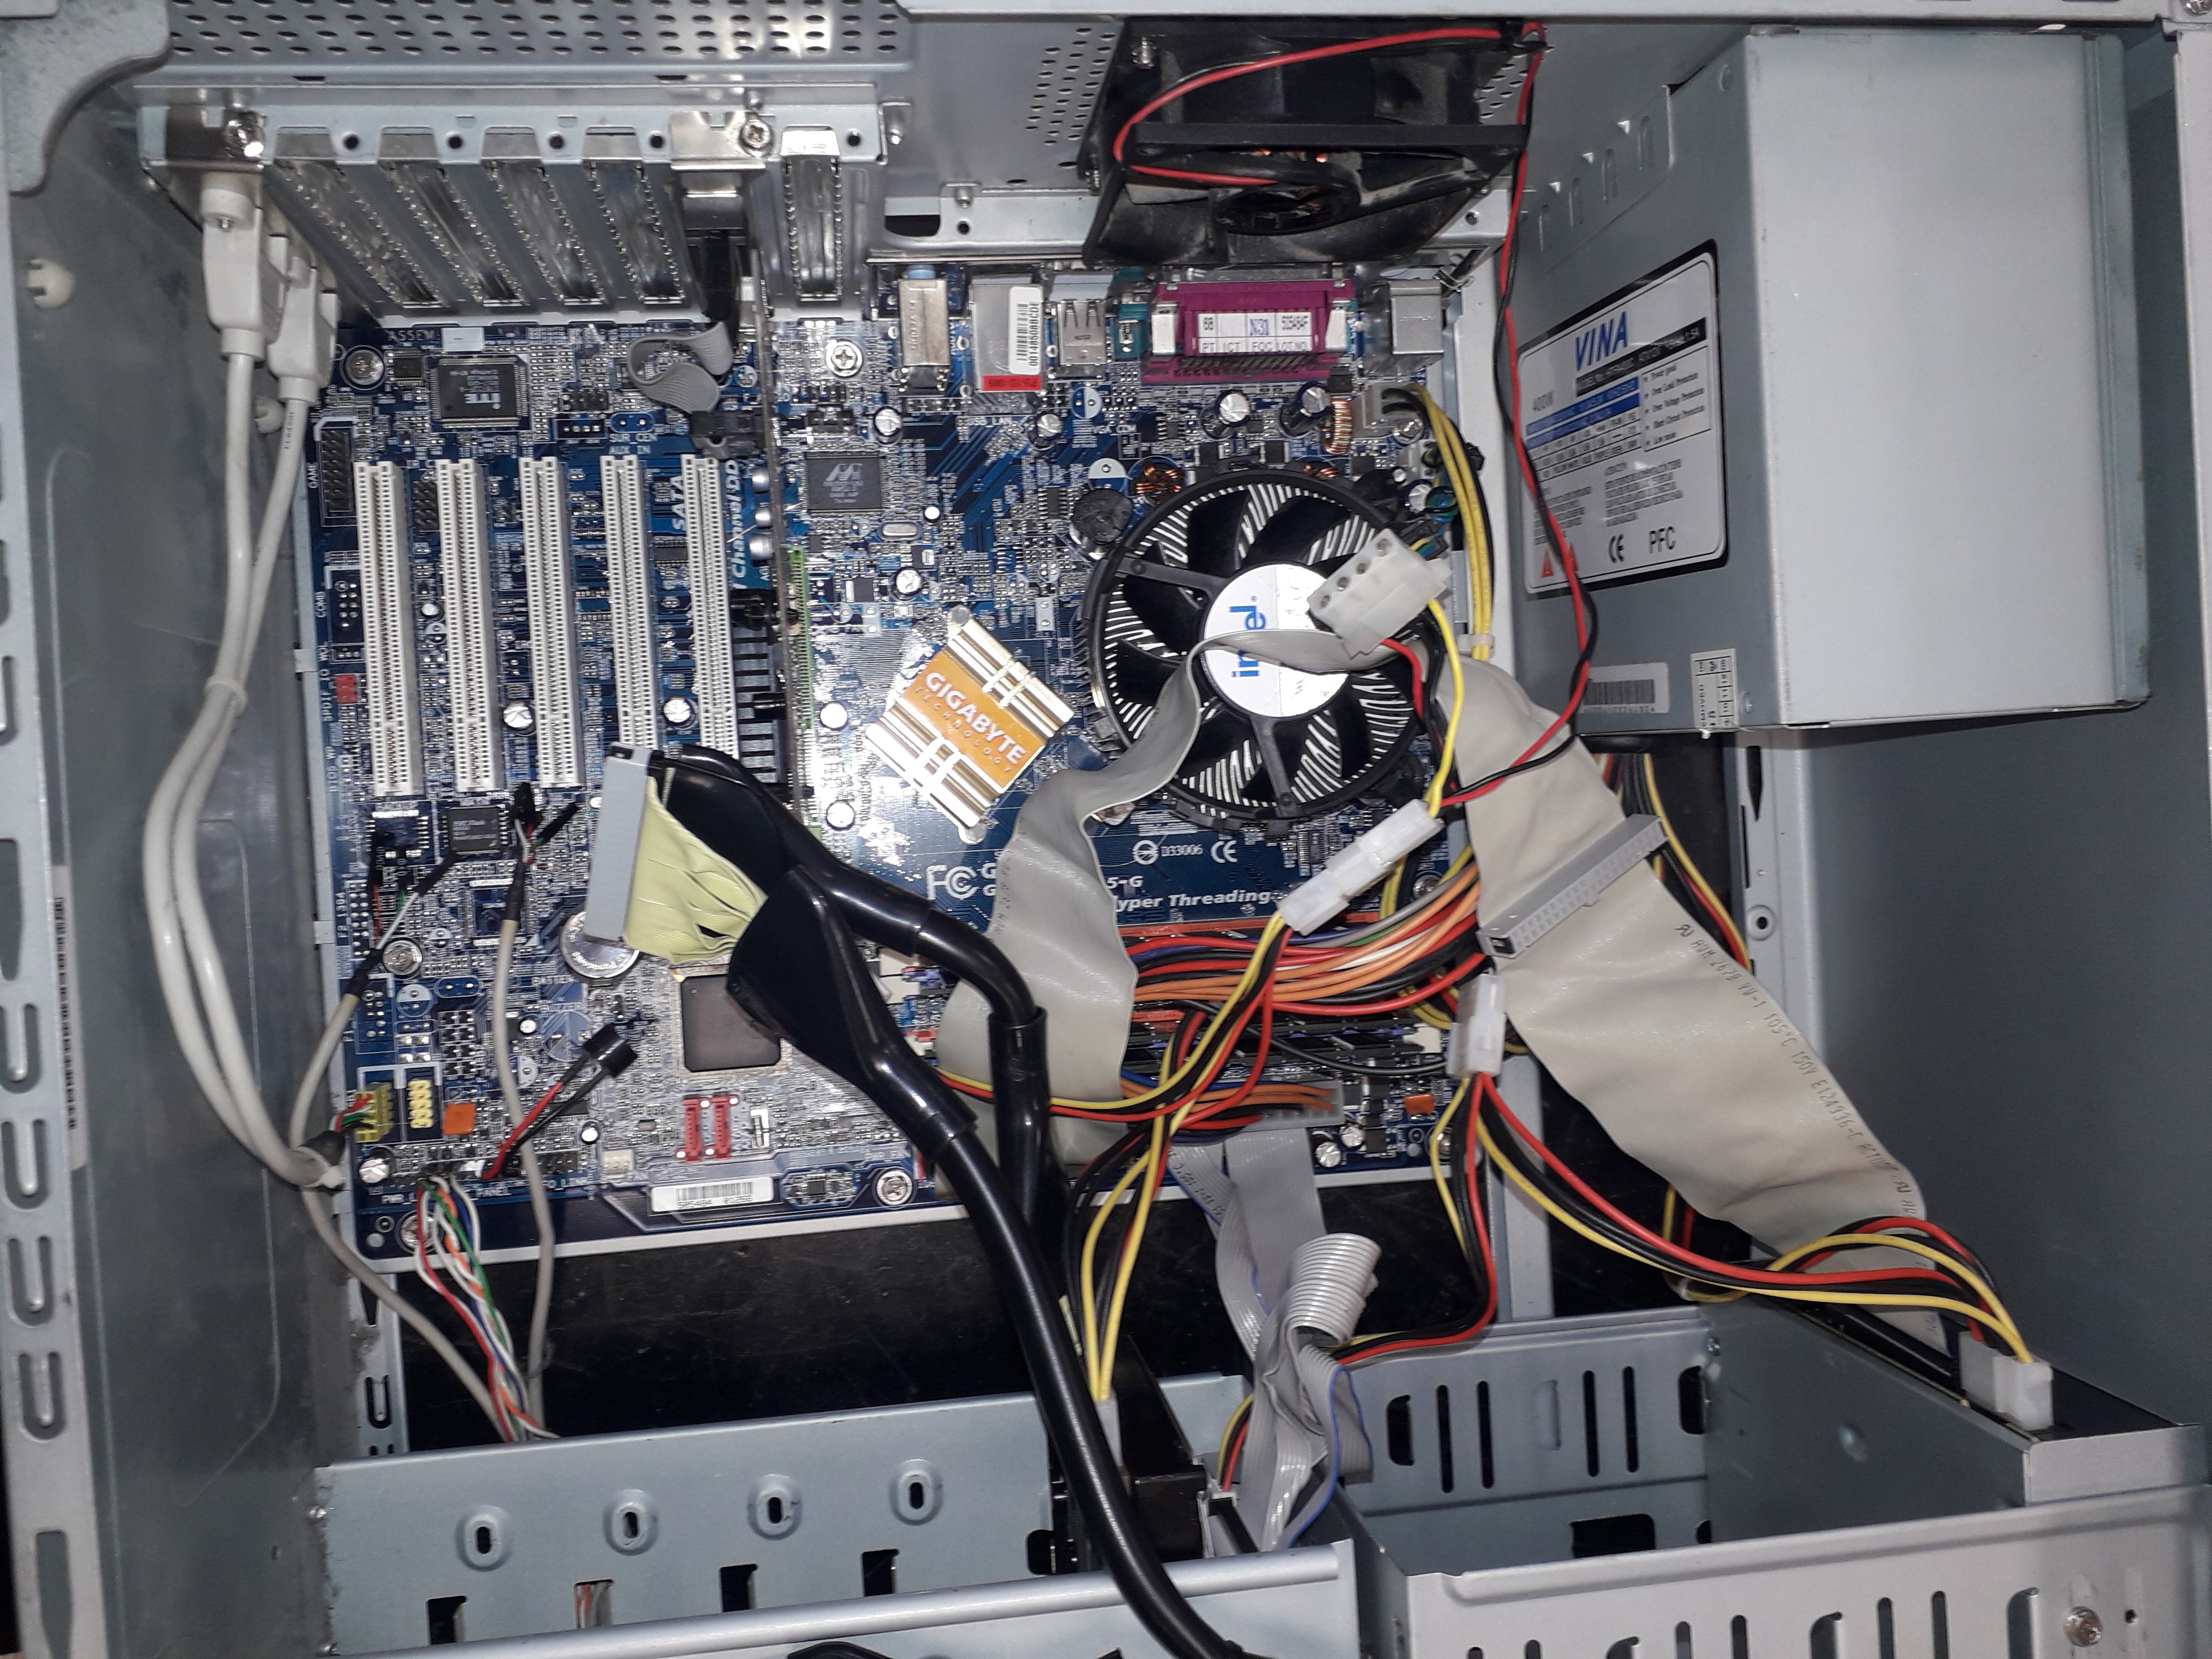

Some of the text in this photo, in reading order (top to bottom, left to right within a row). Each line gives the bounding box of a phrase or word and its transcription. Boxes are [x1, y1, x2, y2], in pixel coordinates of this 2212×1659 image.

[1574, 312, 1628, 371] VINA
[669, 476, 686, 531] SATA
[1649, 526, 1676, 554] PFC
[1228, 604, 1266, 678] inel
[924, 672, 1028, 765] GIGABYTE
[1115, 896, 1164, 913] yper
[1168, 890, 1273, 908] Threading
[1763, 1013, 1798, 1048] 105°C
